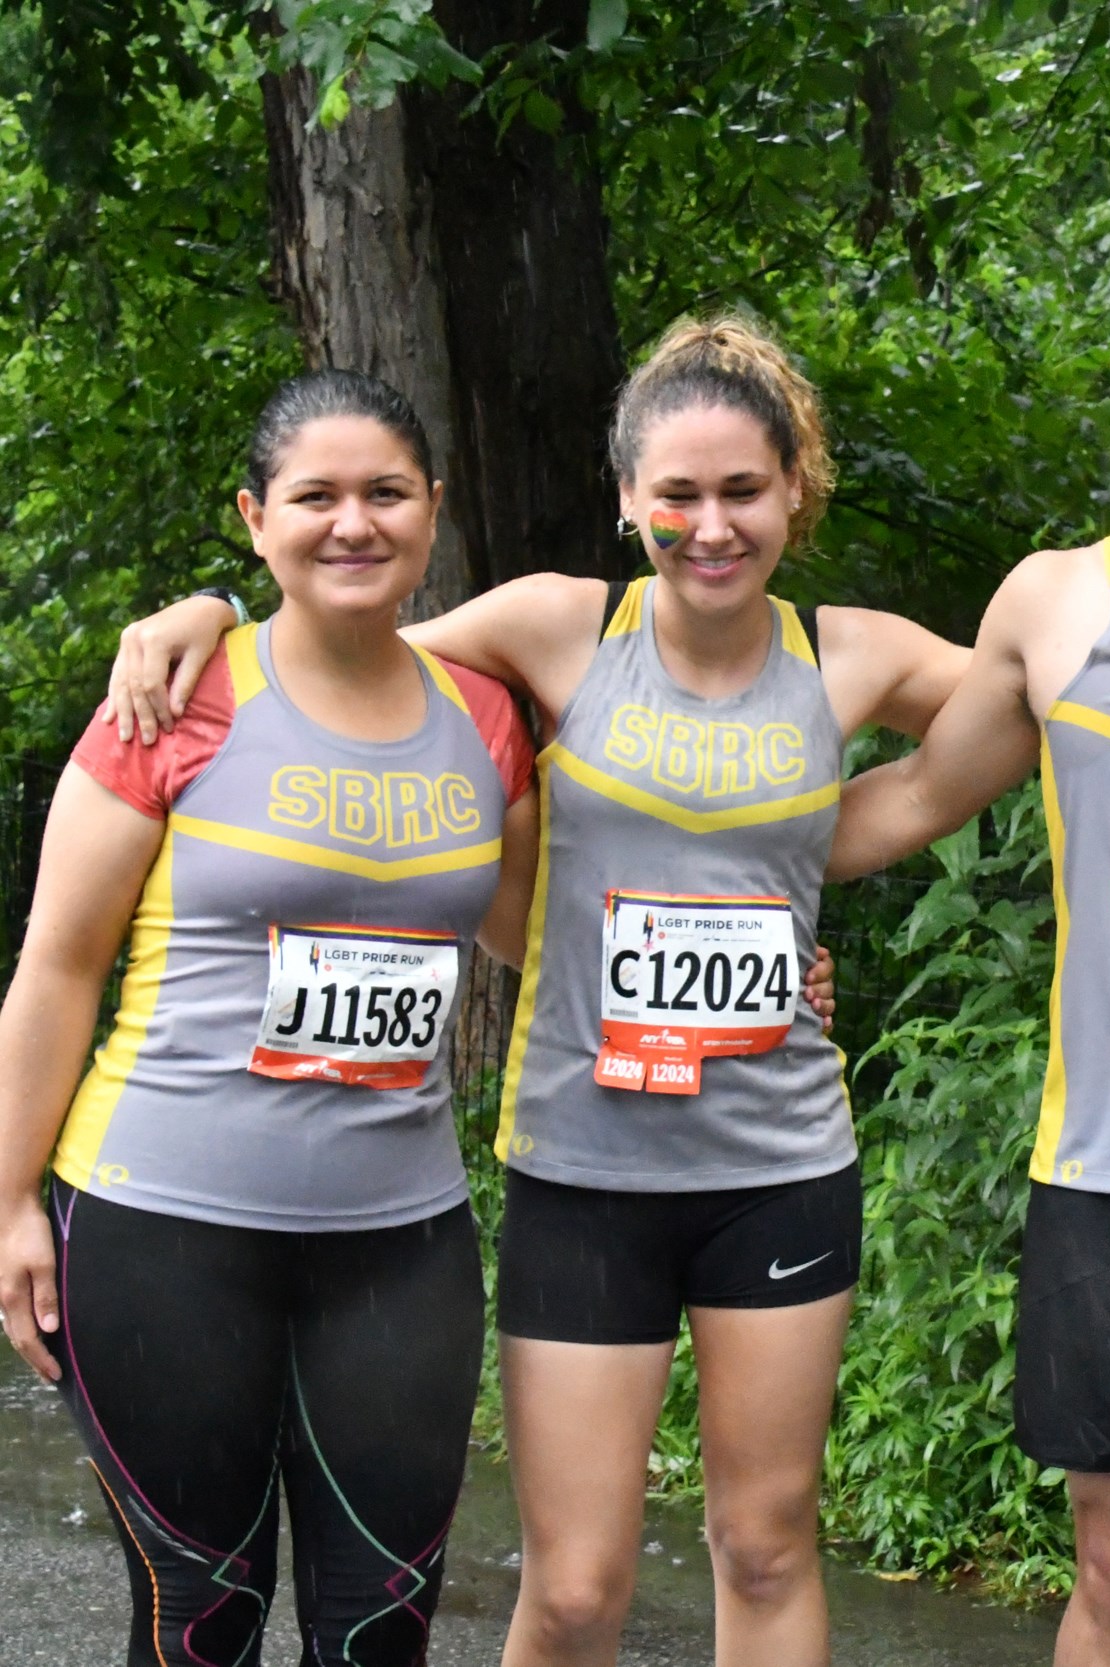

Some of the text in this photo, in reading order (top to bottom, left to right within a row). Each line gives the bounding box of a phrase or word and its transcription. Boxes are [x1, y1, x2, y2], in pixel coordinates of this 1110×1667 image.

[604, 703, 806, 798] SBRC
[268, 765, 481, 848] SBRC
[658, 917, 763, 930] LGBT PRIDE RUN
[324, 949, 425, 966] LGBT PRIDE RUN
[610, 949, 793, 1012] C12024
[601, 1057, 644, 1079] 12024
[651, 1063, 695, 1083] 12024
